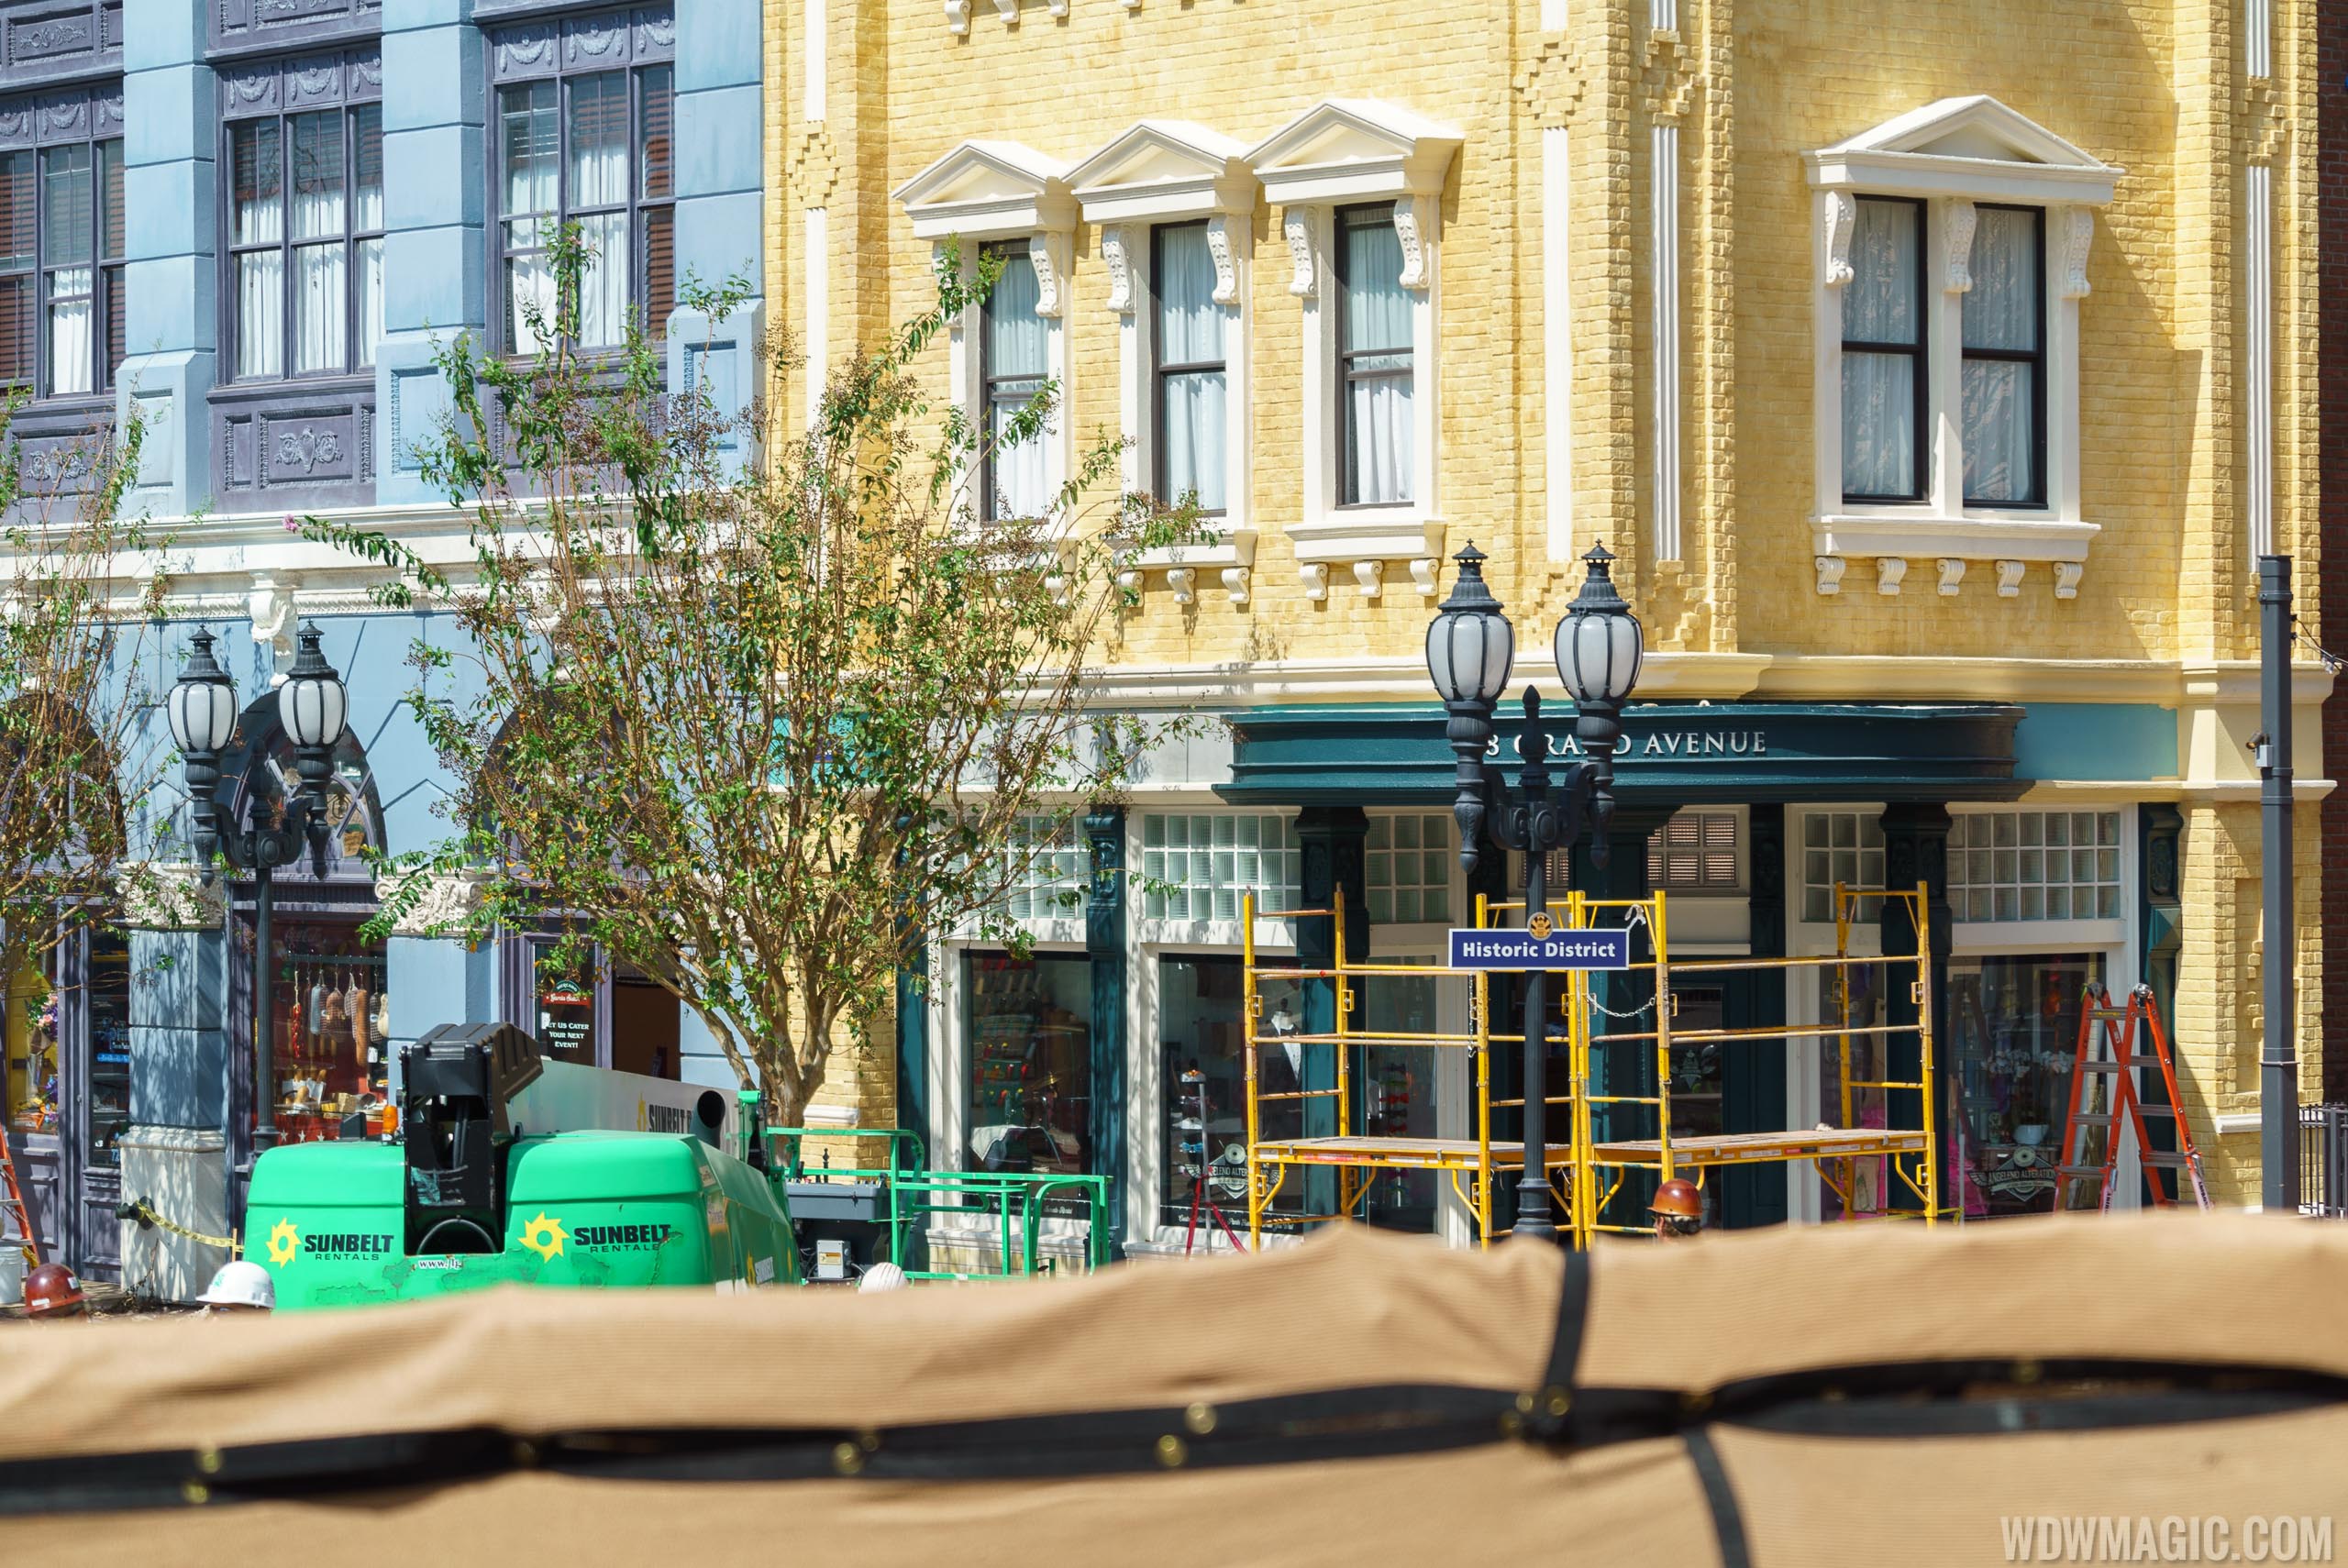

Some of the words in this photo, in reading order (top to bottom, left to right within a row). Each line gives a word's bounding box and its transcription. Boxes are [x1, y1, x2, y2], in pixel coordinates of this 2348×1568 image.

[1513, 734, 1632, 756] RAD
[1643, 732, 1767, 756] AVENUE
[1462, 942, 1539, 957] Historic
[1545, 942, 1616, 957] District
[554, 1041, 579, 1049] EVENT!
[305, 1234, 394, 1253] SUNBELT
[573, 1224, 671, 1246] SUNBELT
